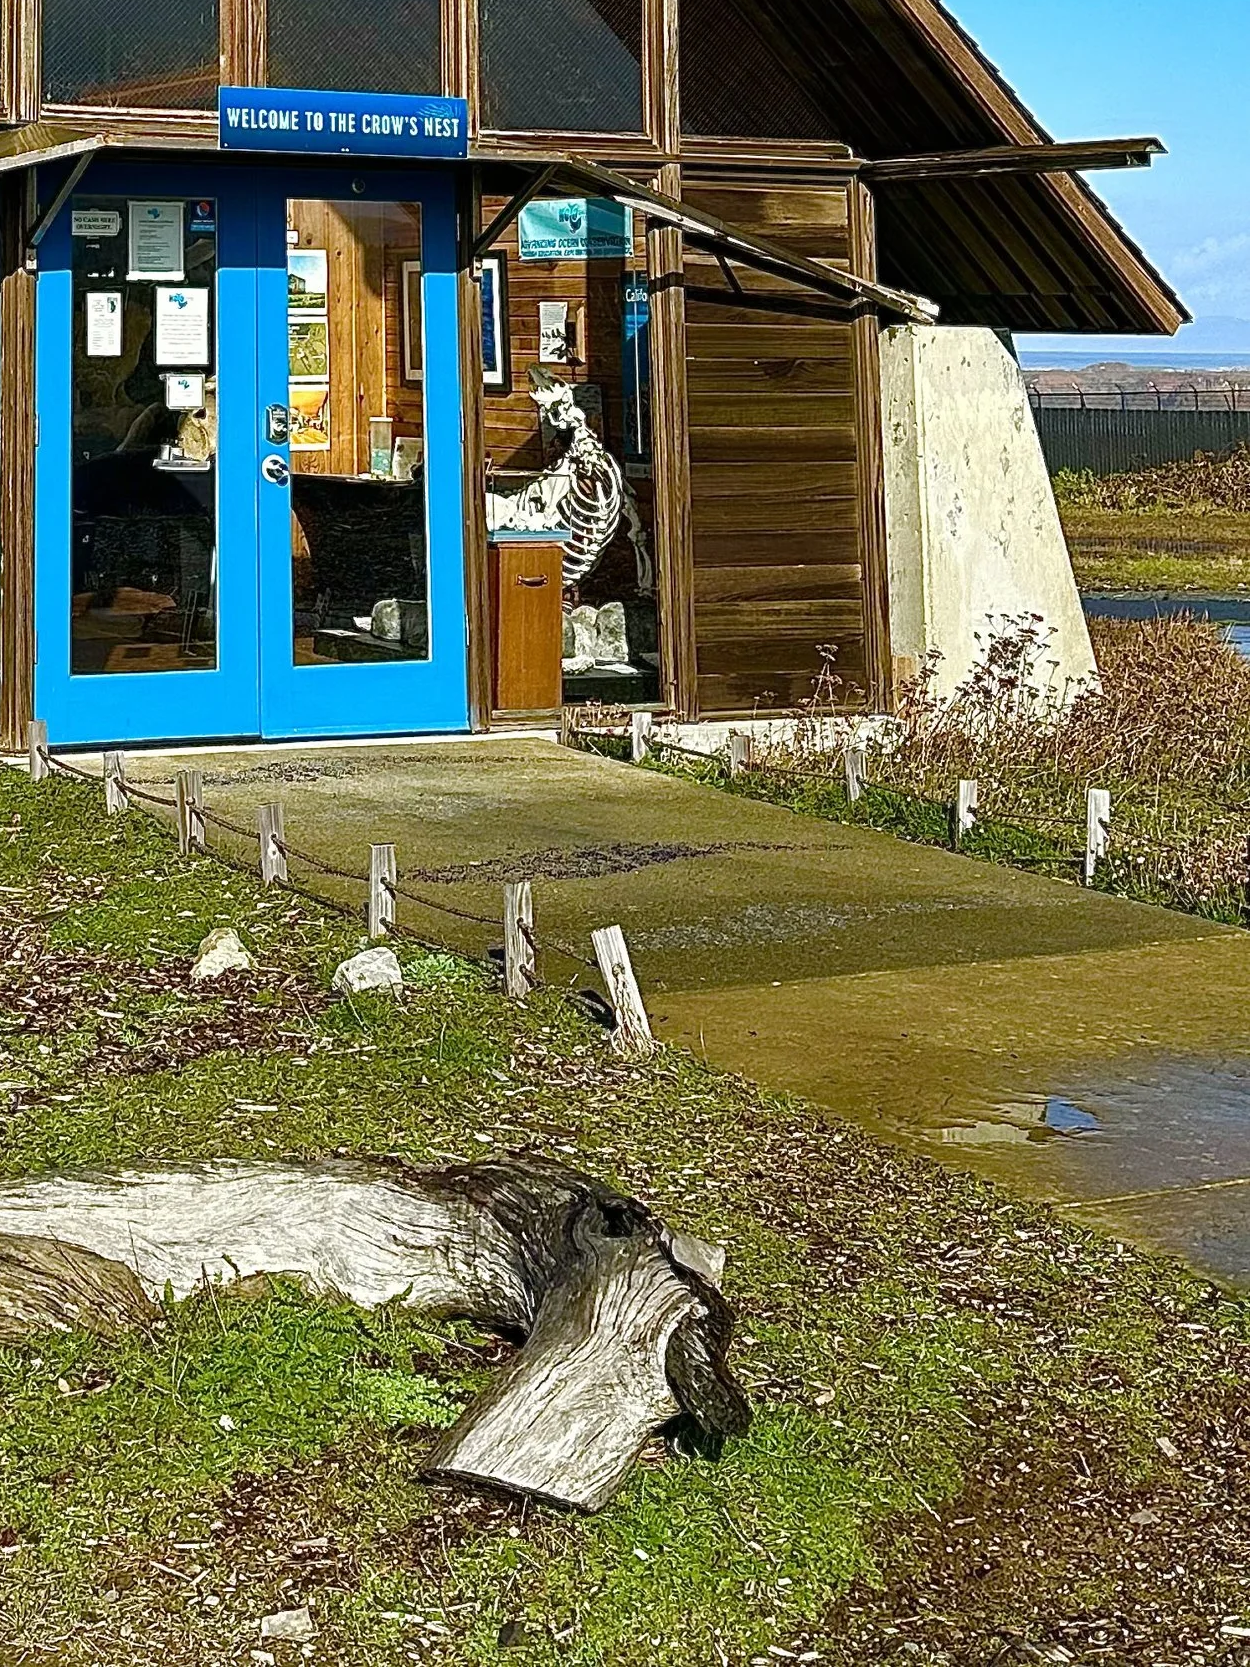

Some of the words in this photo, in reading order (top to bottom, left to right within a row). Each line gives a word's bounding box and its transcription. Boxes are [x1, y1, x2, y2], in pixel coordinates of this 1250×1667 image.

[226, 107, 299, 130] WELCOME
[304, 111, 323, 131] TO
[329, 112, 356, 133] THE
[362, 114, 418, 136] CROW'S
[424, 117, 459, 138] NEST
